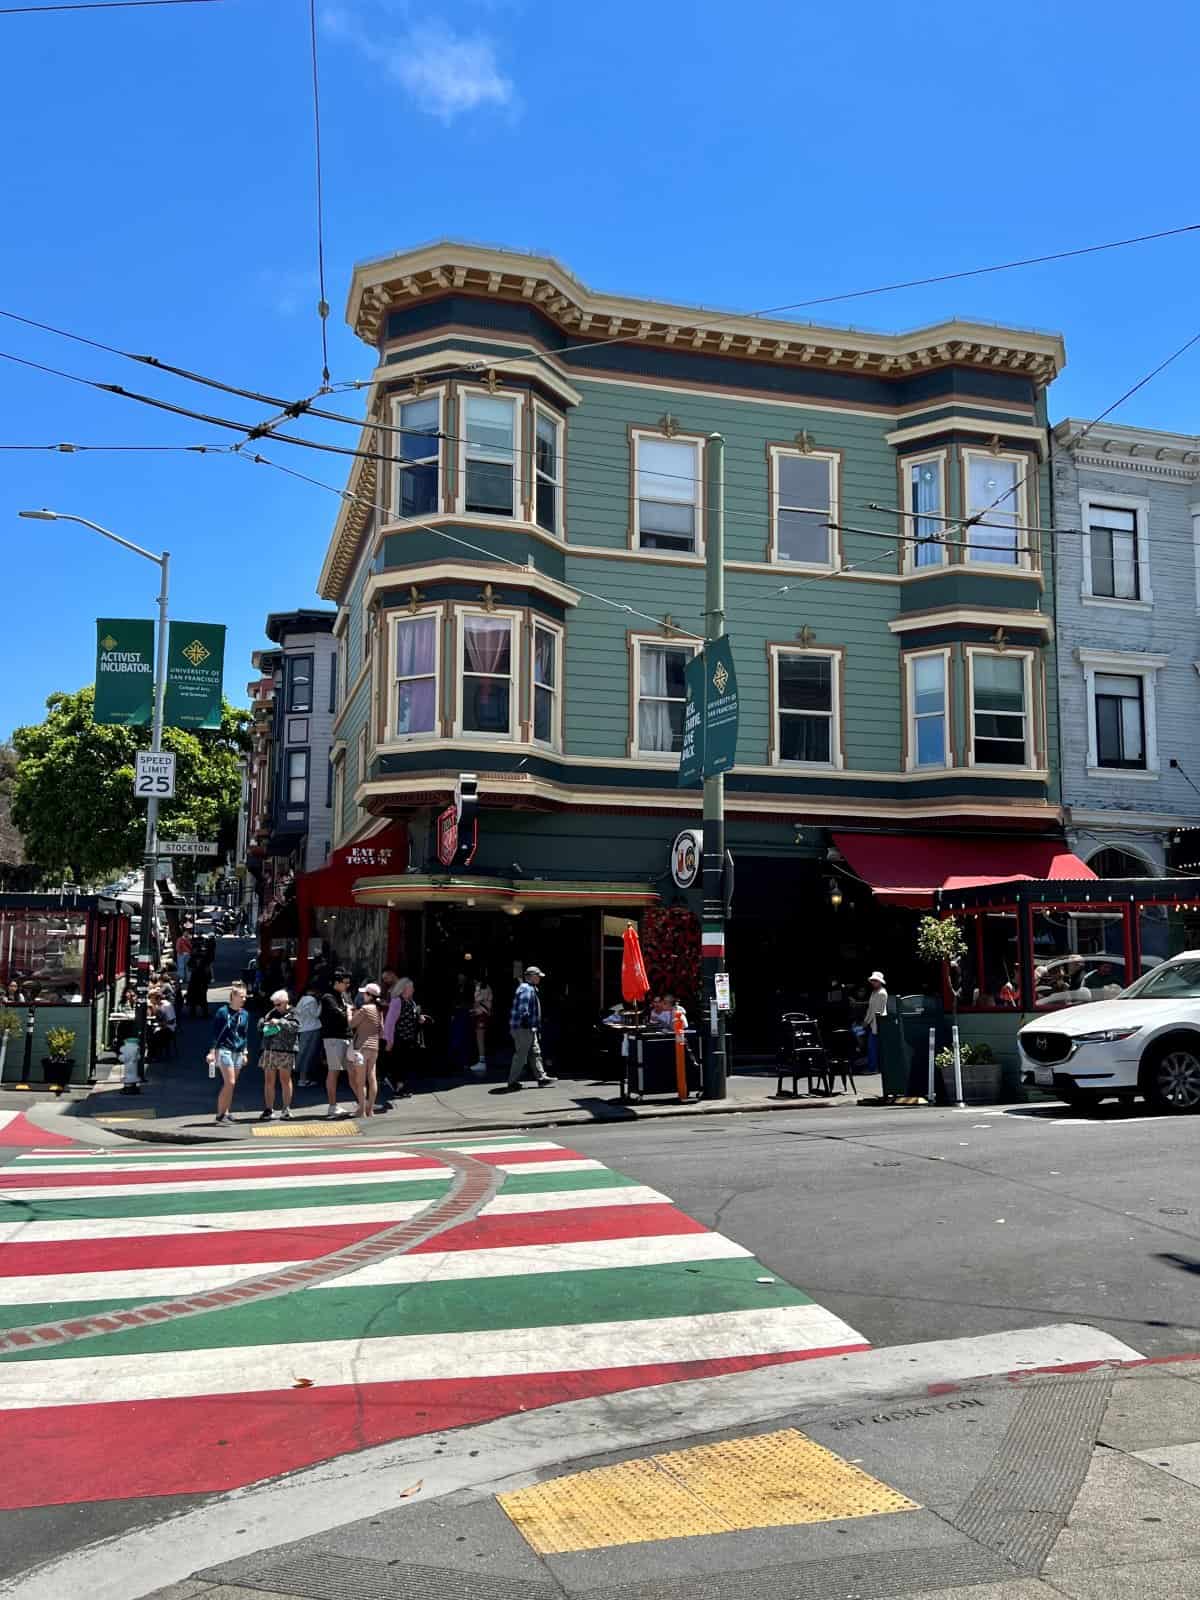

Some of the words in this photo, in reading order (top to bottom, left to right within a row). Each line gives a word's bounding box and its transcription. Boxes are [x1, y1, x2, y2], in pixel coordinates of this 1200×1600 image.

[101, 652, 141, 662] ACTIVIST
[101, 663, 152, 673] INCUBATOR.
[170, 668, 209, 676] UNIVERSITY
[184, 675, 219, 683] FRANCISCO
[140, 756, 171, 765] SPEED
[142, 766, 168, 774] LIMIT
[139, 776, 170, 793] 25
[166, 843, 211, 852] STOCKTON
[352, 847, 375, 856] EAT
[829, 1398, 985, 1431] STOCKTON
